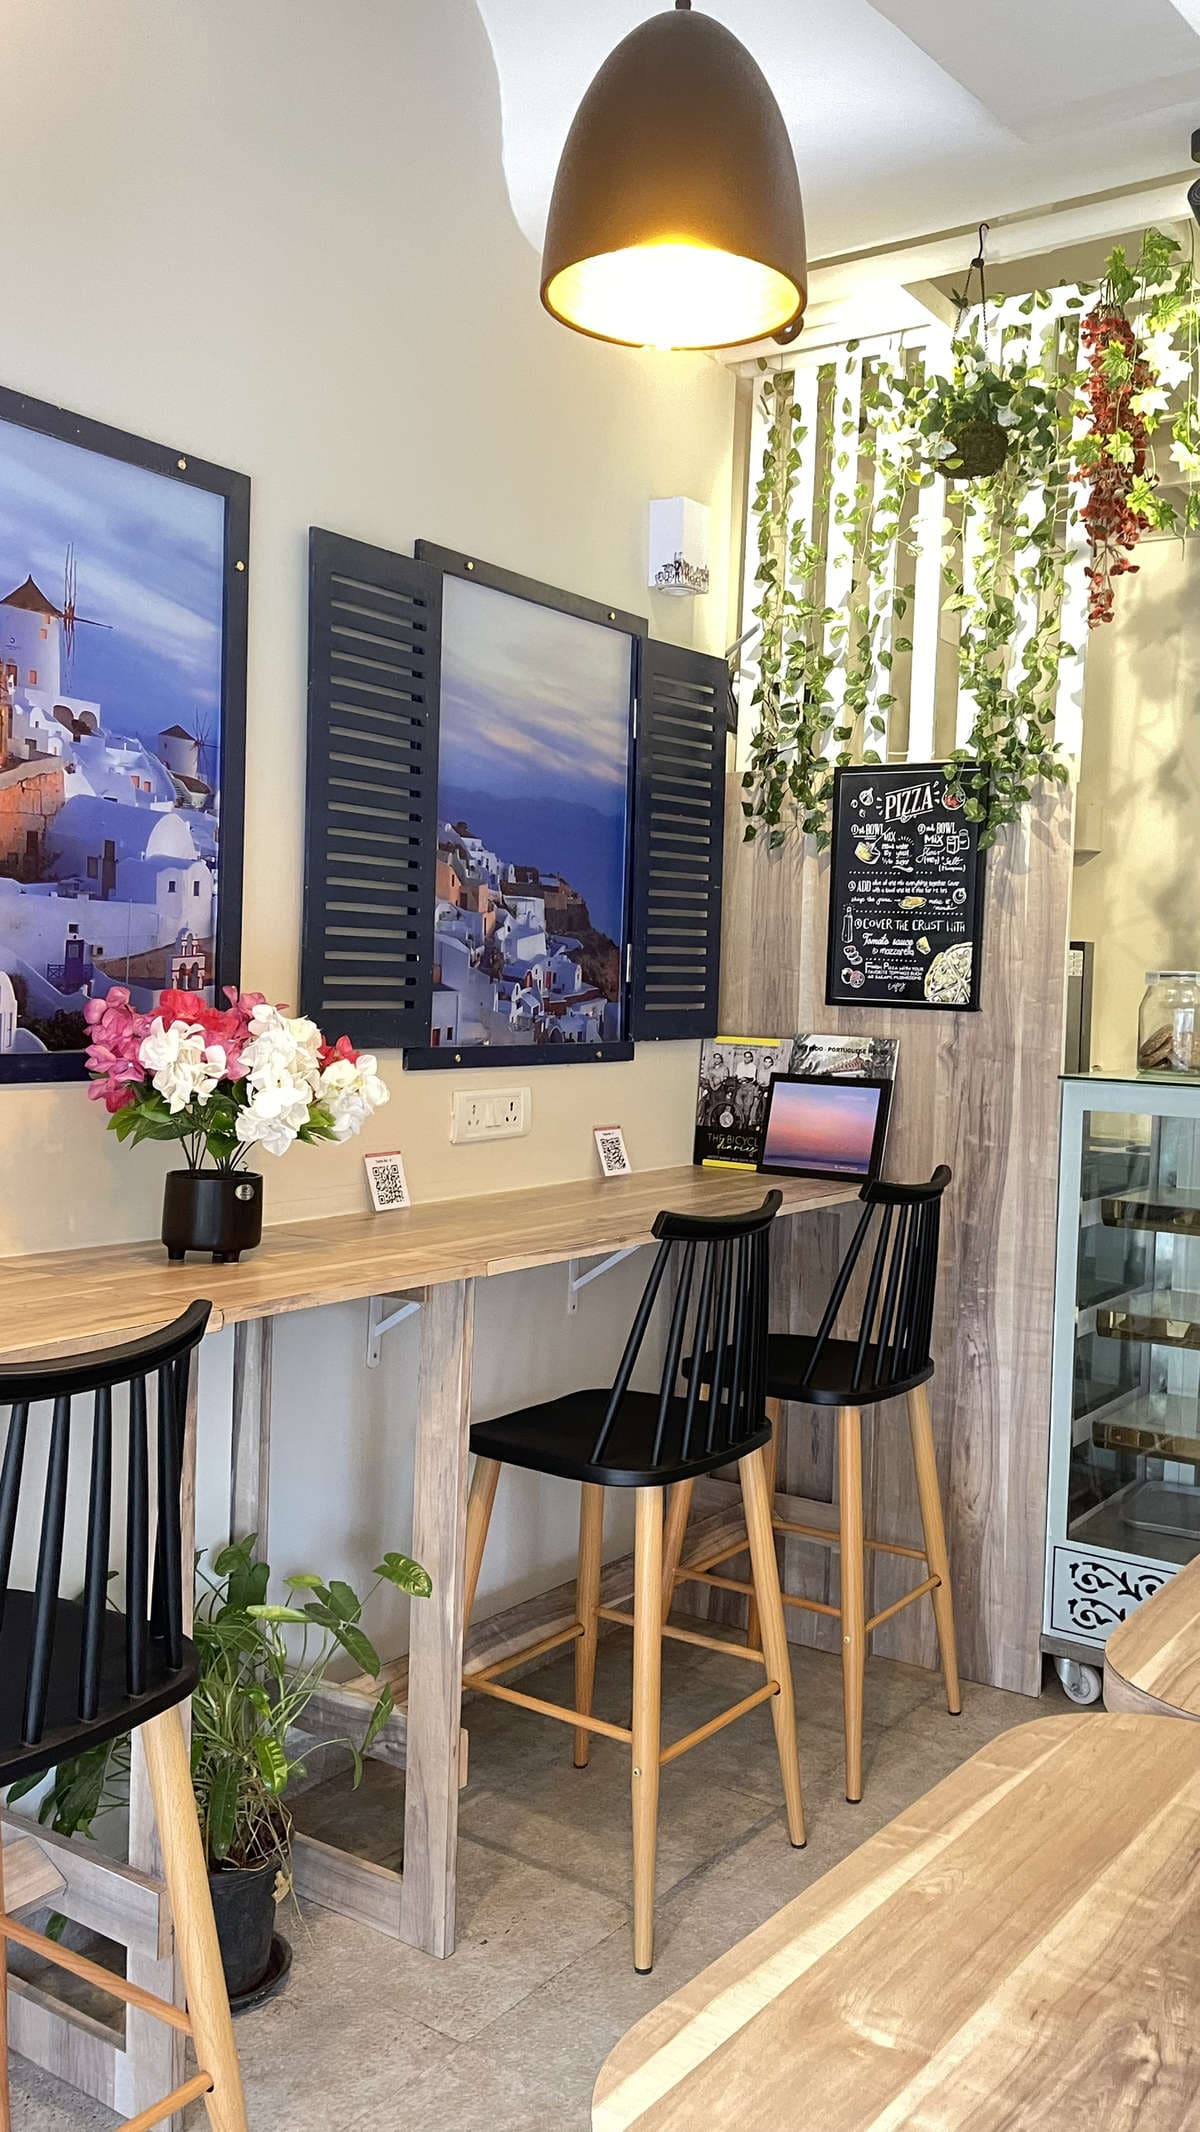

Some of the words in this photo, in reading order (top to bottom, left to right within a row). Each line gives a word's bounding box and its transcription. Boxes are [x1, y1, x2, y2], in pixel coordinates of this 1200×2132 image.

[885, 785, 934, 820] PIZZA
[936, 821, 957, 834] BOWL
[857, 880, 872, 893] ADD
[862, 918, 894, 930] COVER
[894, 920, 910, 932] THE
[912, 920, 945, 932] CRUST
[862, 933, 890, 947] Tomato
[708, 1132, 725, 1144] THE
[726, 1134, 760, 1147] BICYCL
